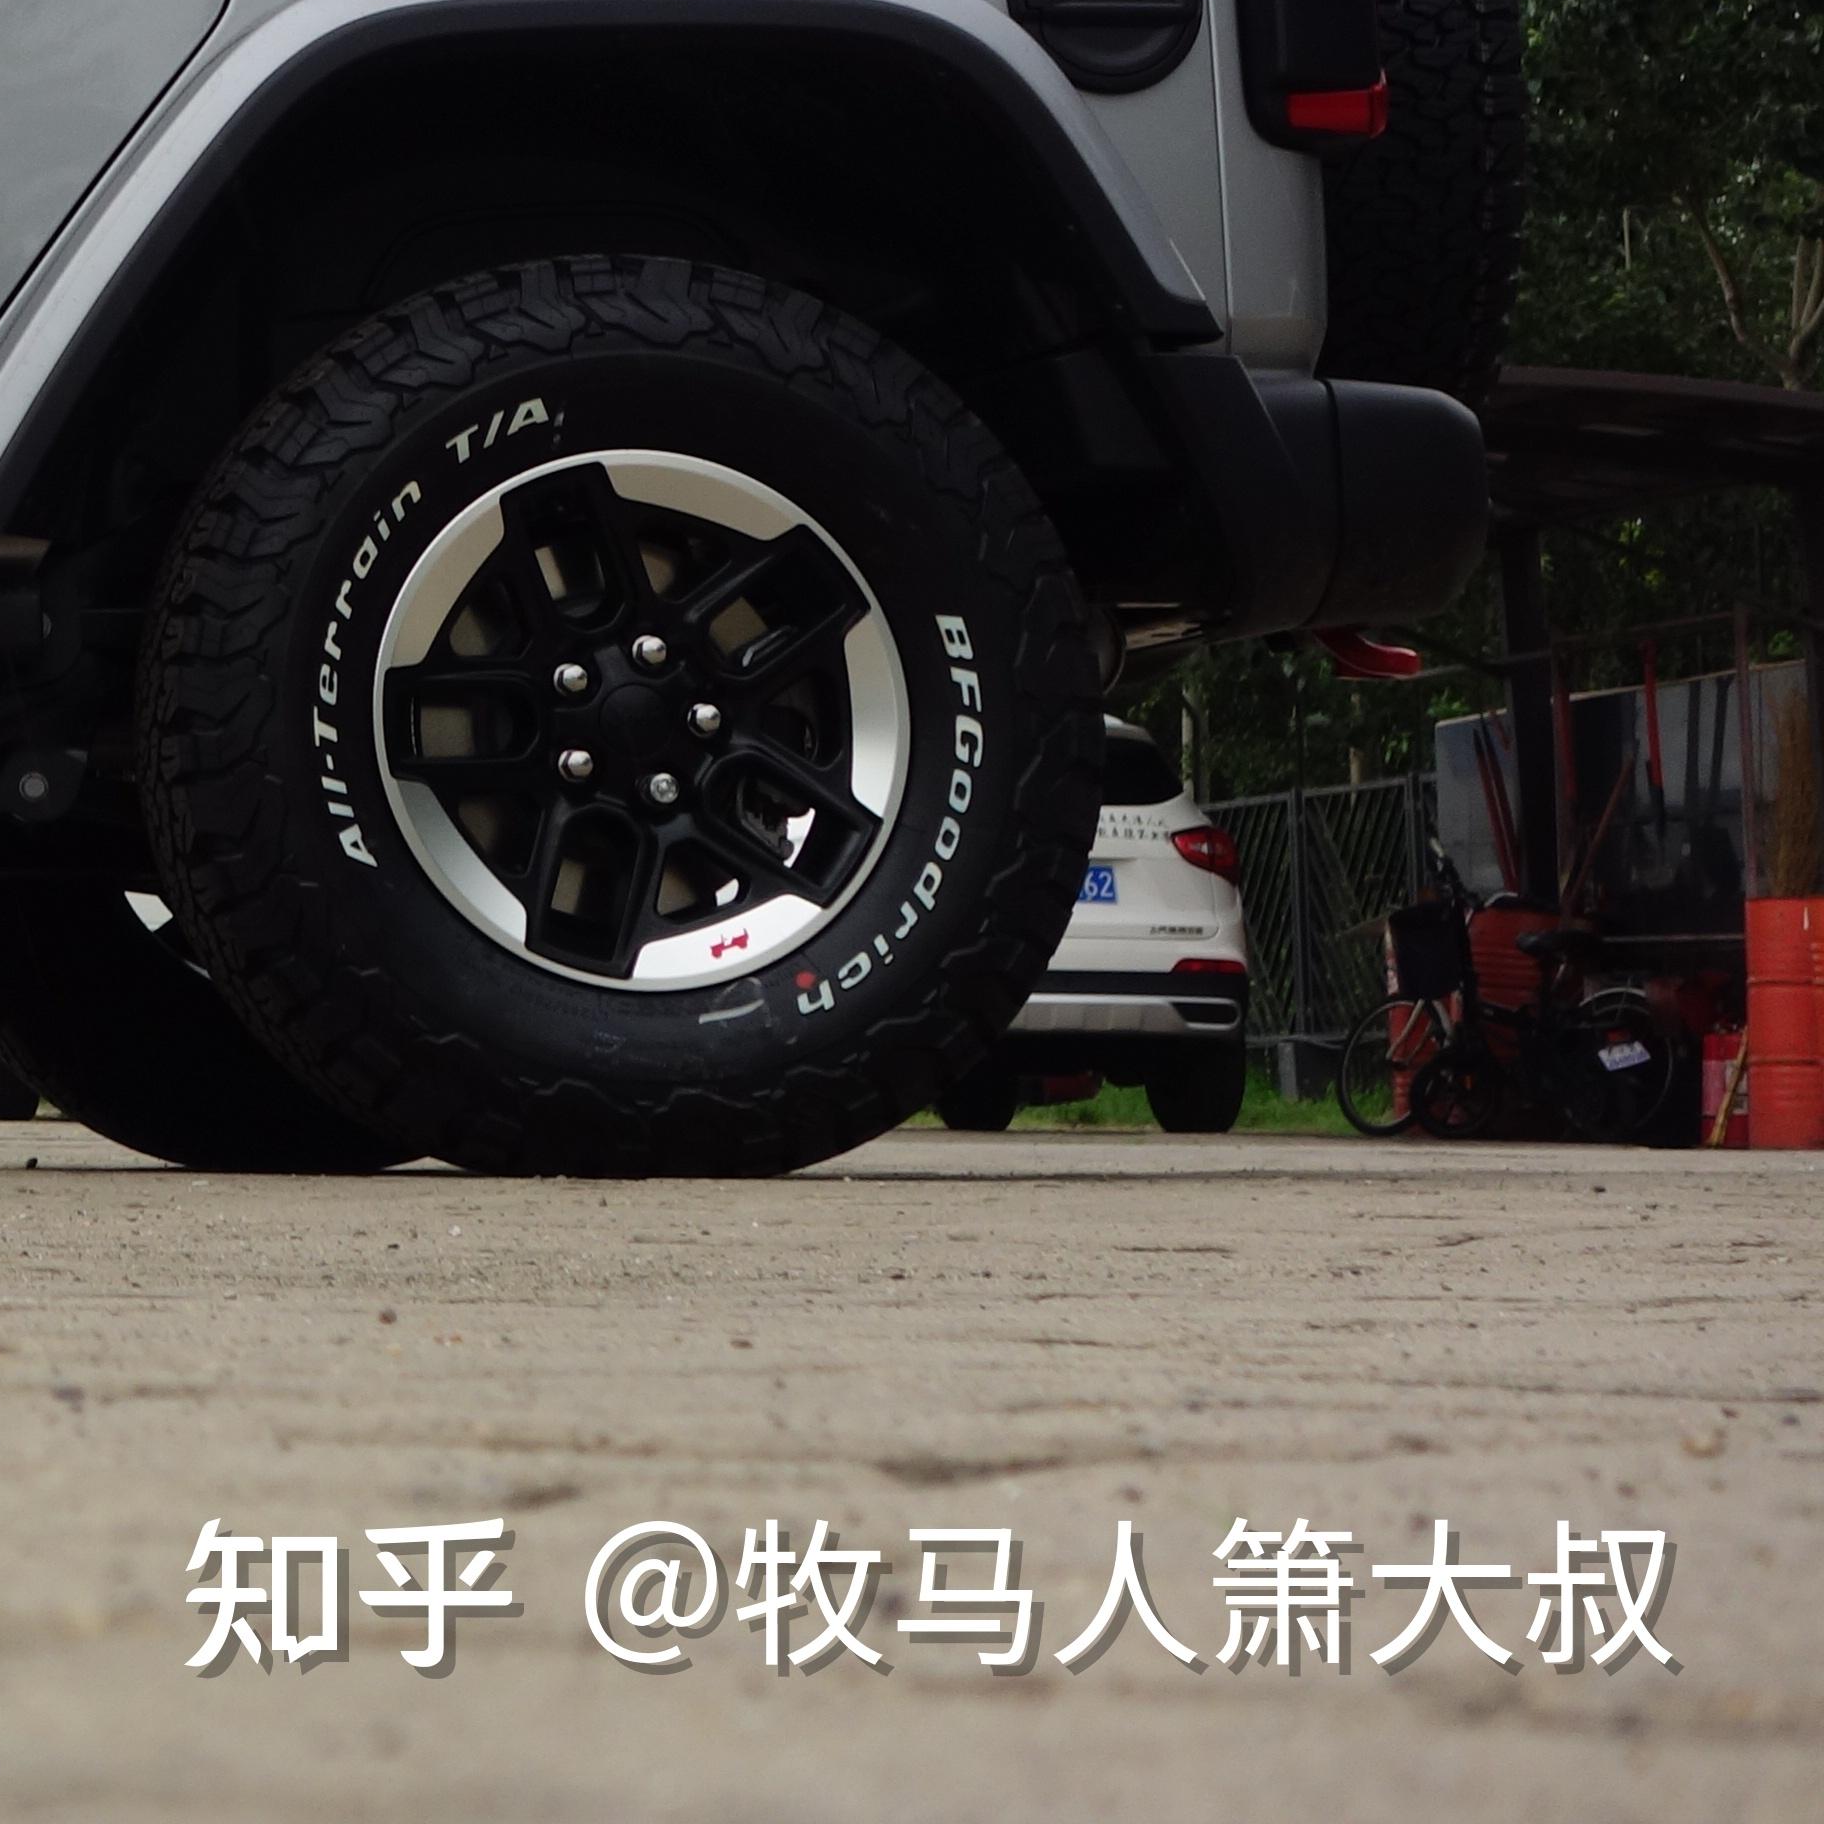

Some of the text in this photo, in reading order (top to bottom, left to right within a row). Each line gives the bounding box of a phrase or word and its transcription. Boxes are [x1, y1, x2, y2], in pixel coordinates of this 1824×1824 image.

[313, 398, 549, 867] All-Terrain T/A
[797, 614, 983, 1015] BFGoodrich
